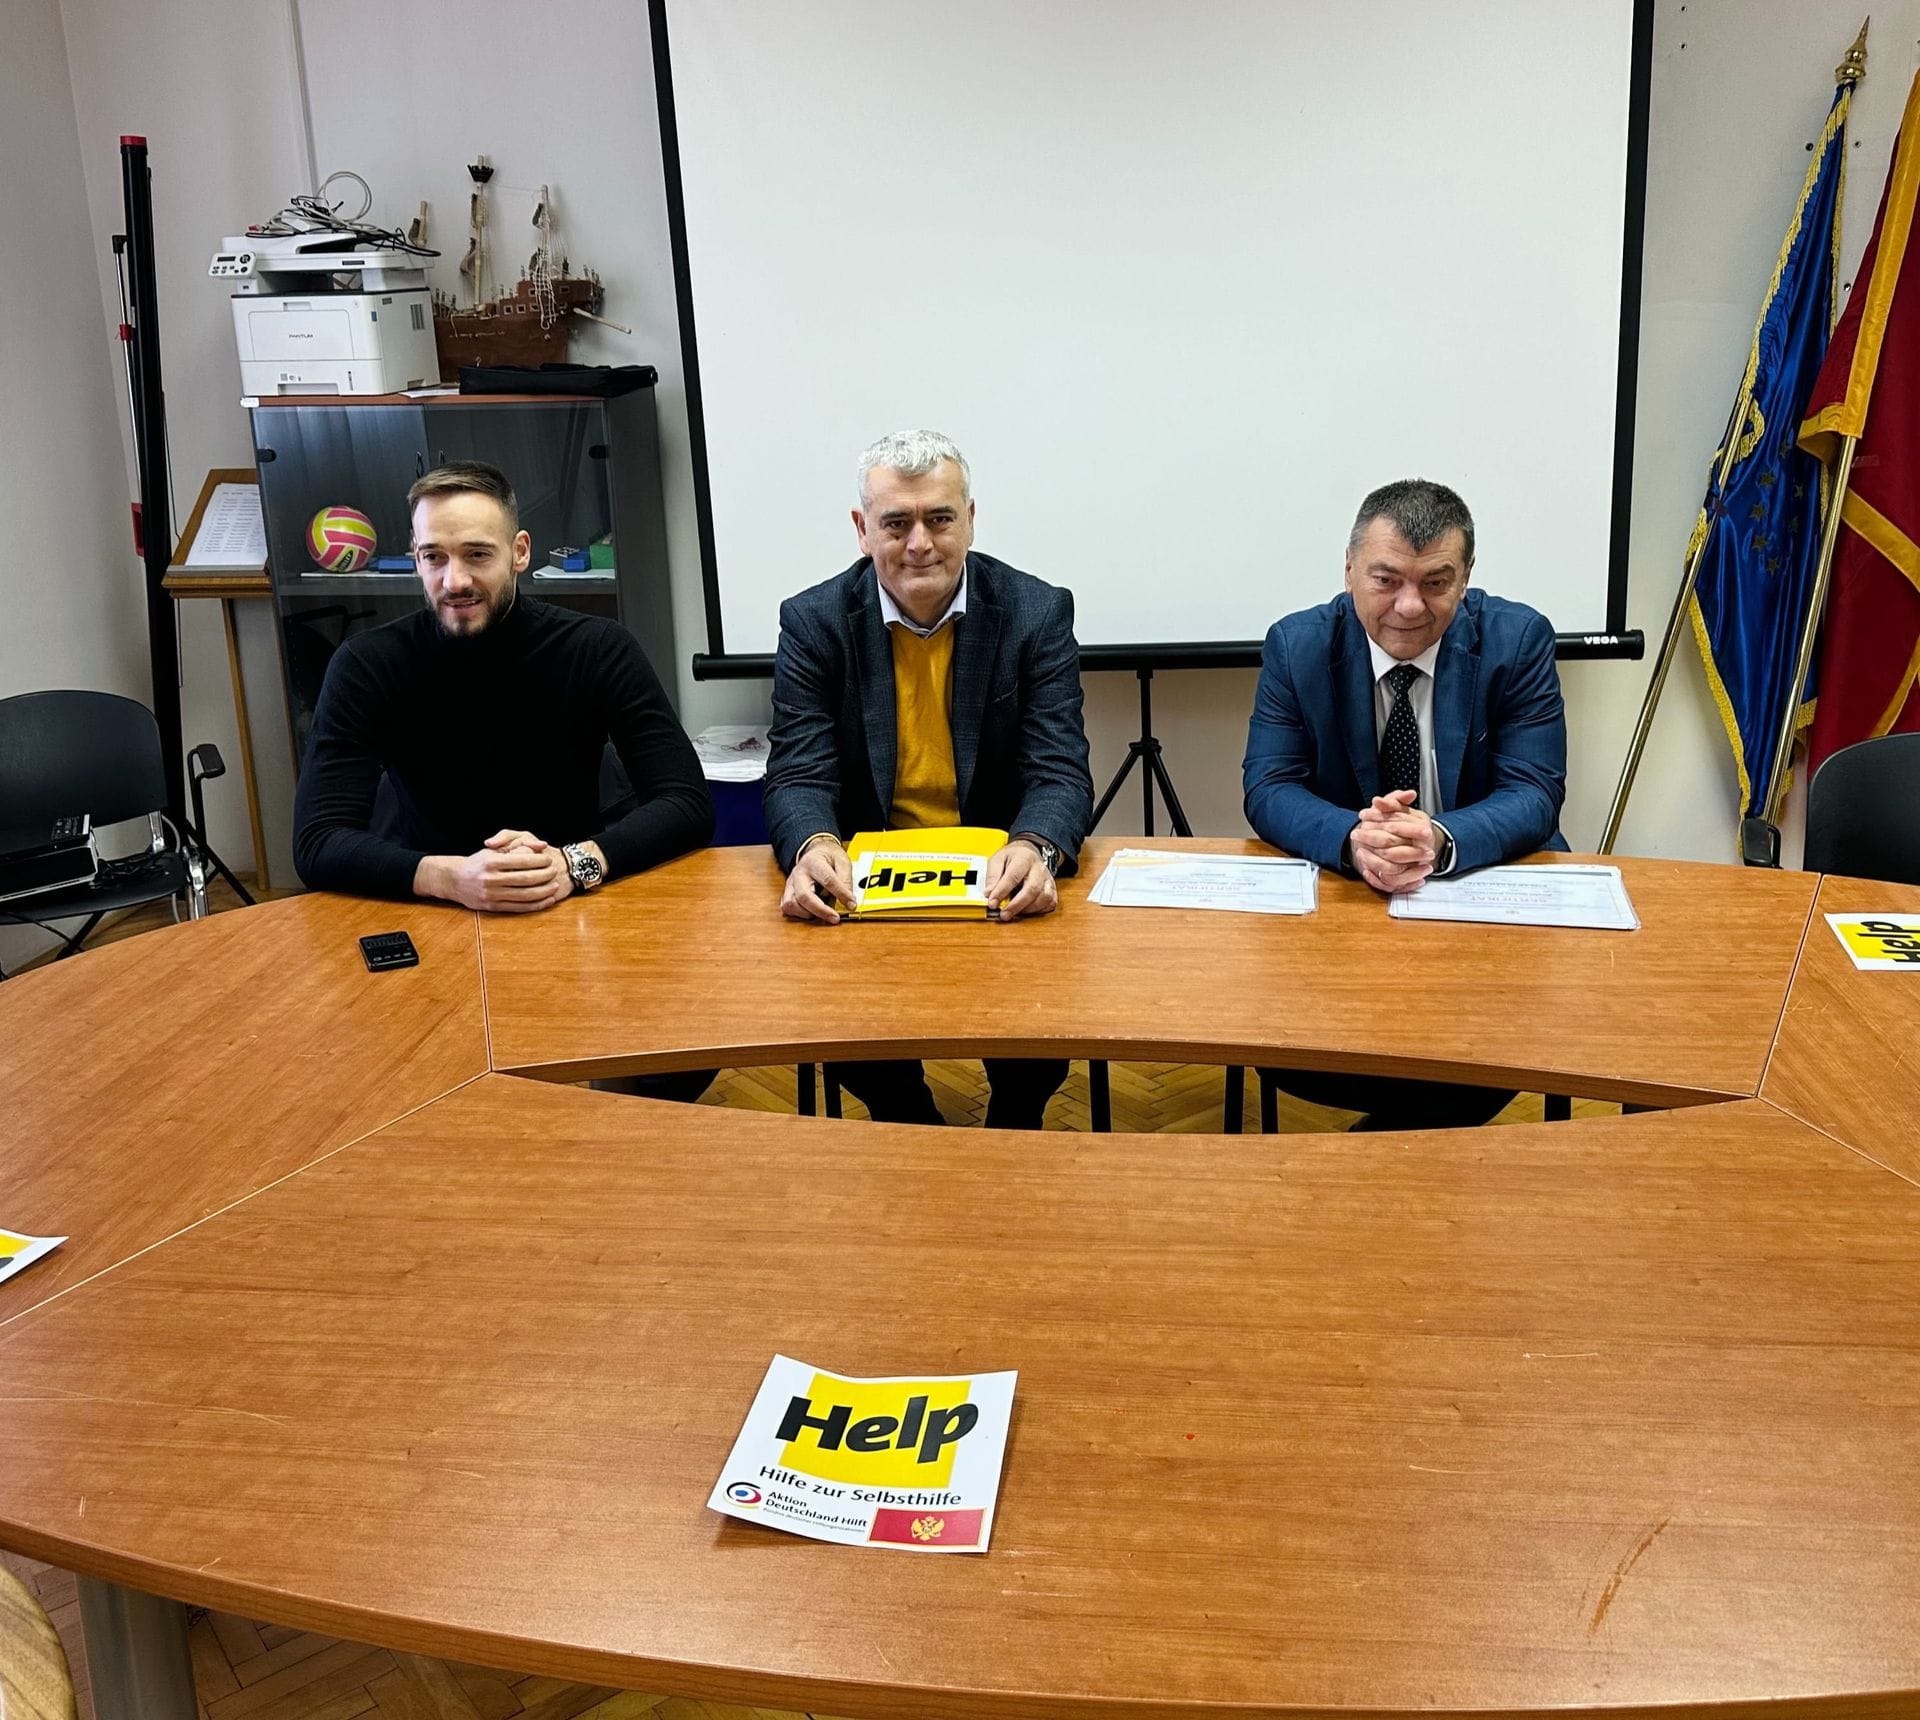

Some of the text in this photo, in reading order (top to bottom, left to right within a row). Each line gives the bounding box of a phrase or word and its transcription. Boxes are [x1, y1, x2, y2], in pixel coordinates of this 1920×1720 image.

[1583, 635, 1619, 645] VEGA
[857, 867, 978, 893] Help
[775, 1395, 979, 1464] Help
[759, 1465, 962, 1506] Hilfe zur Selbsthilfe
[768, 1491, 808, 1508] Aktion
[765, 1498, 868, 1528] Deutschland Hilft
